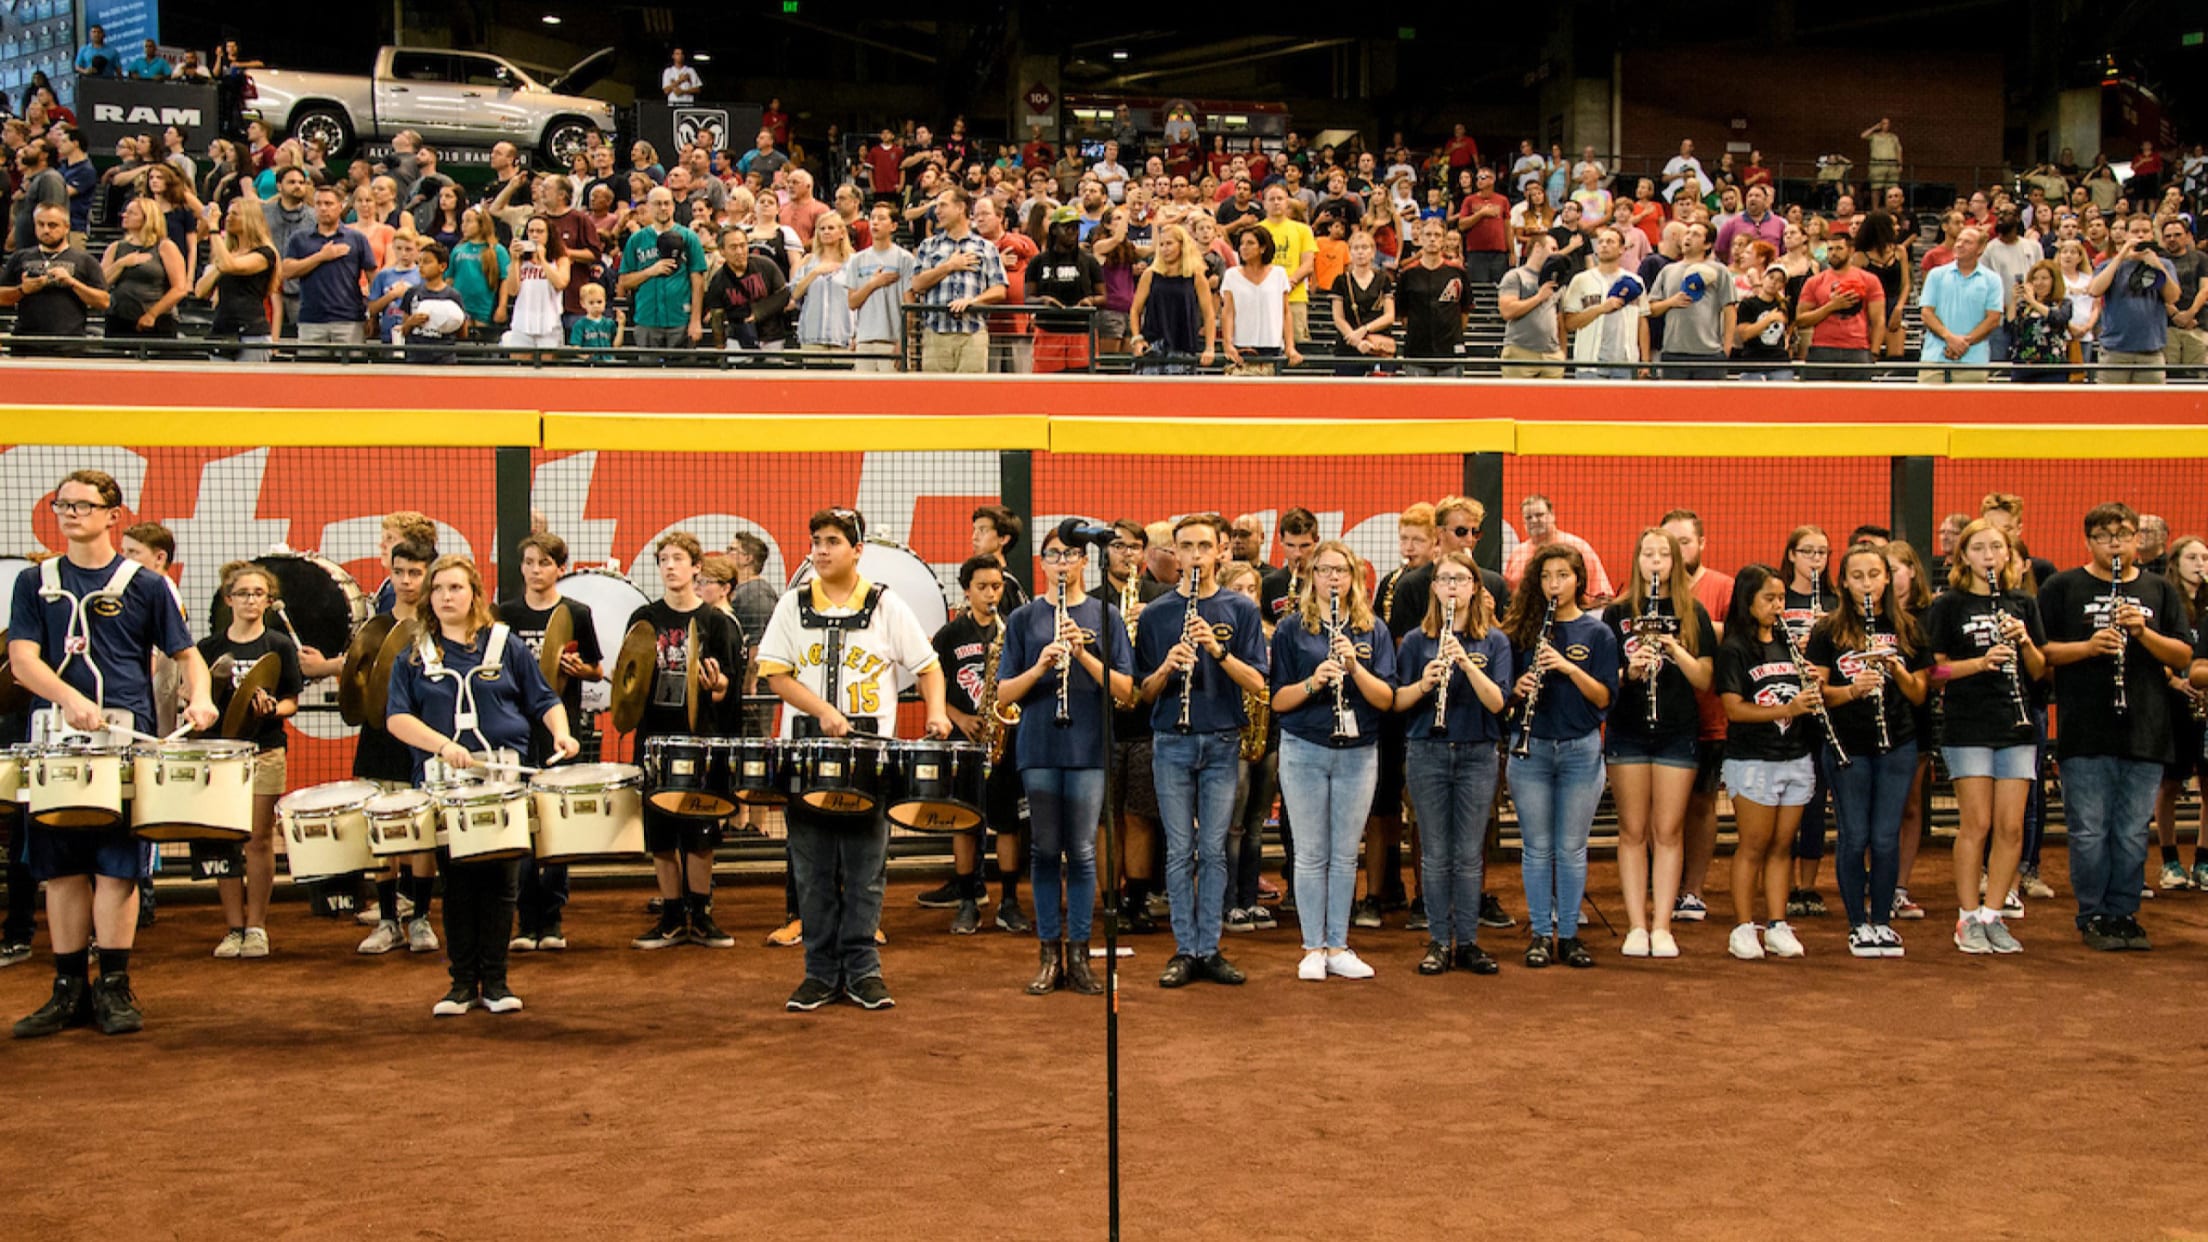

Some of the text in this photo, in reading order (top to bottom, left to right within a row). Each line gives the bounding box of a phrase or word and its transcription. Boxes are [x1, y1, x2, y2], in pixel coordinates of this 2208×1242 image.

[1030, 93, 1050, 104] 104
[93, 103, 201, 126] RAM
[847, 681, 881, 714] 15
[831, 794, 862, 808] Pearl
[925, 812, 956, 827] Pearl
[201, 859, 230, 876] VIC
[326, 895, 354, 911] VIC
